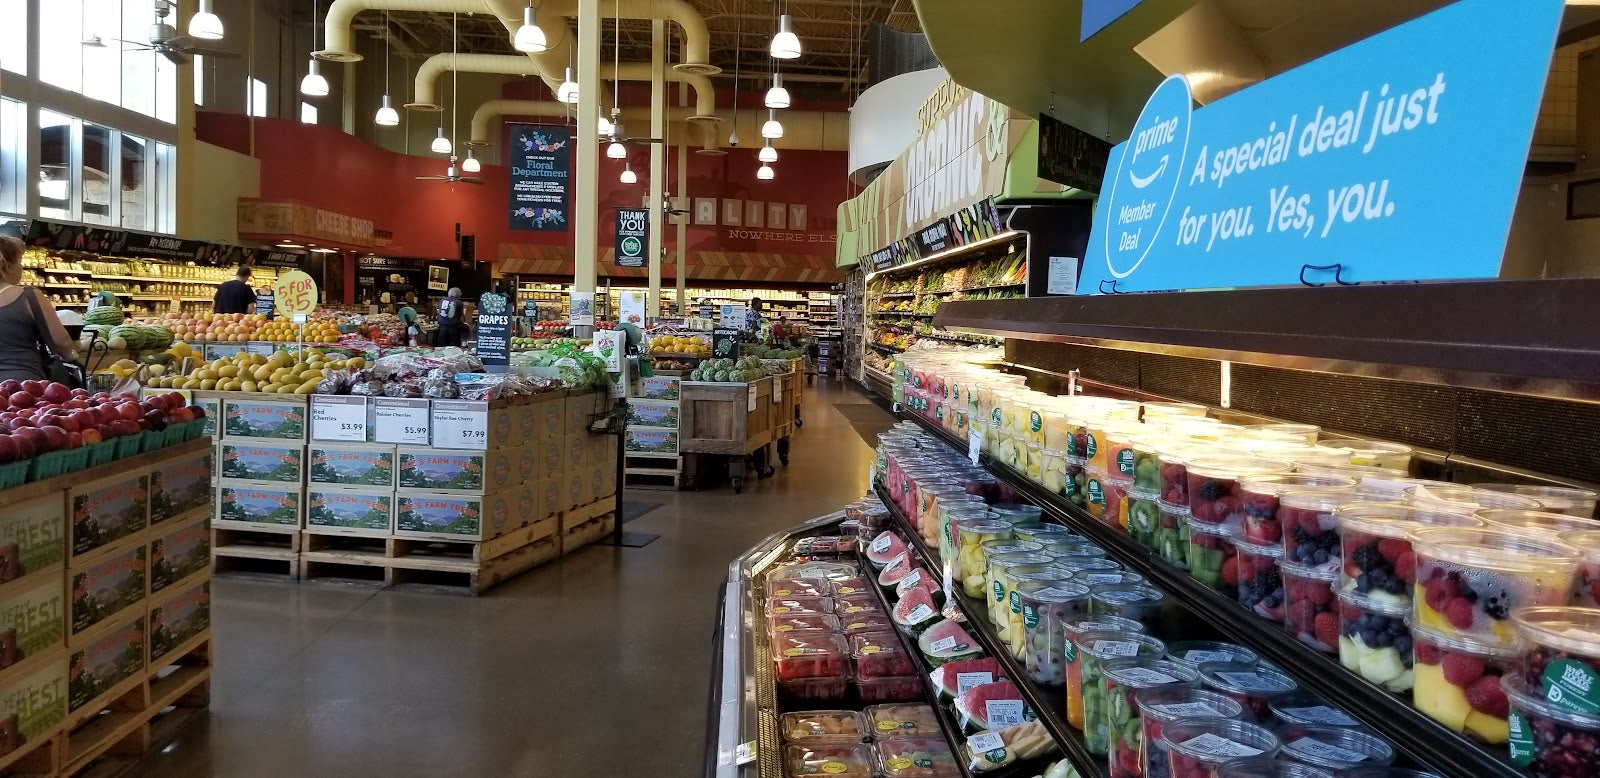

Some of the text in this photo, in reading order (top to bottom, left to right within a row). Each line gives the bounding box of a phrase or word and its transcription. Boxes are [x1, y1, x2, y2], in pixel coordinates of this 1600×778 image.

[917, 76, 968, 139] SUPPO
[1132, 115, 1179, 164] prime
[1189, 145, 1208, 186] A
[1210, 114, 1298, 188] special
[1298, 90, 1369, 157] deal
[1362, 72, 1446, 154] just
[512, 166, 568, 178] Department
[527, 160, 553, 170] Floral
[906, 91, 985, 228] ORGANIC
[317, 209, 374, 239] CHEESE SHOP
[620, 211, 645, 220] THANK
[1118, 200, 1156, 225] Member
[1176, 179, 1395, 252] for you. Yes, you.
[620, 220, 645, 231] YOU
[729, 230, 838, 243] NOWHERE ELS
[1119, 227, 1141, 252] Deal
[278, 279, 312, 298] 5 FOR
[479, 315, 509, 325] GRAPES
[404, 426, 427, 434] $5.99
[462, 430, 485, 438] $7.99
[17, 517, 61, 550] BEST
[15, 595, 60, 635] BEST
[1565, 664, 1595, 686] WHOLE
[17, 676, 62, 718] BEST
